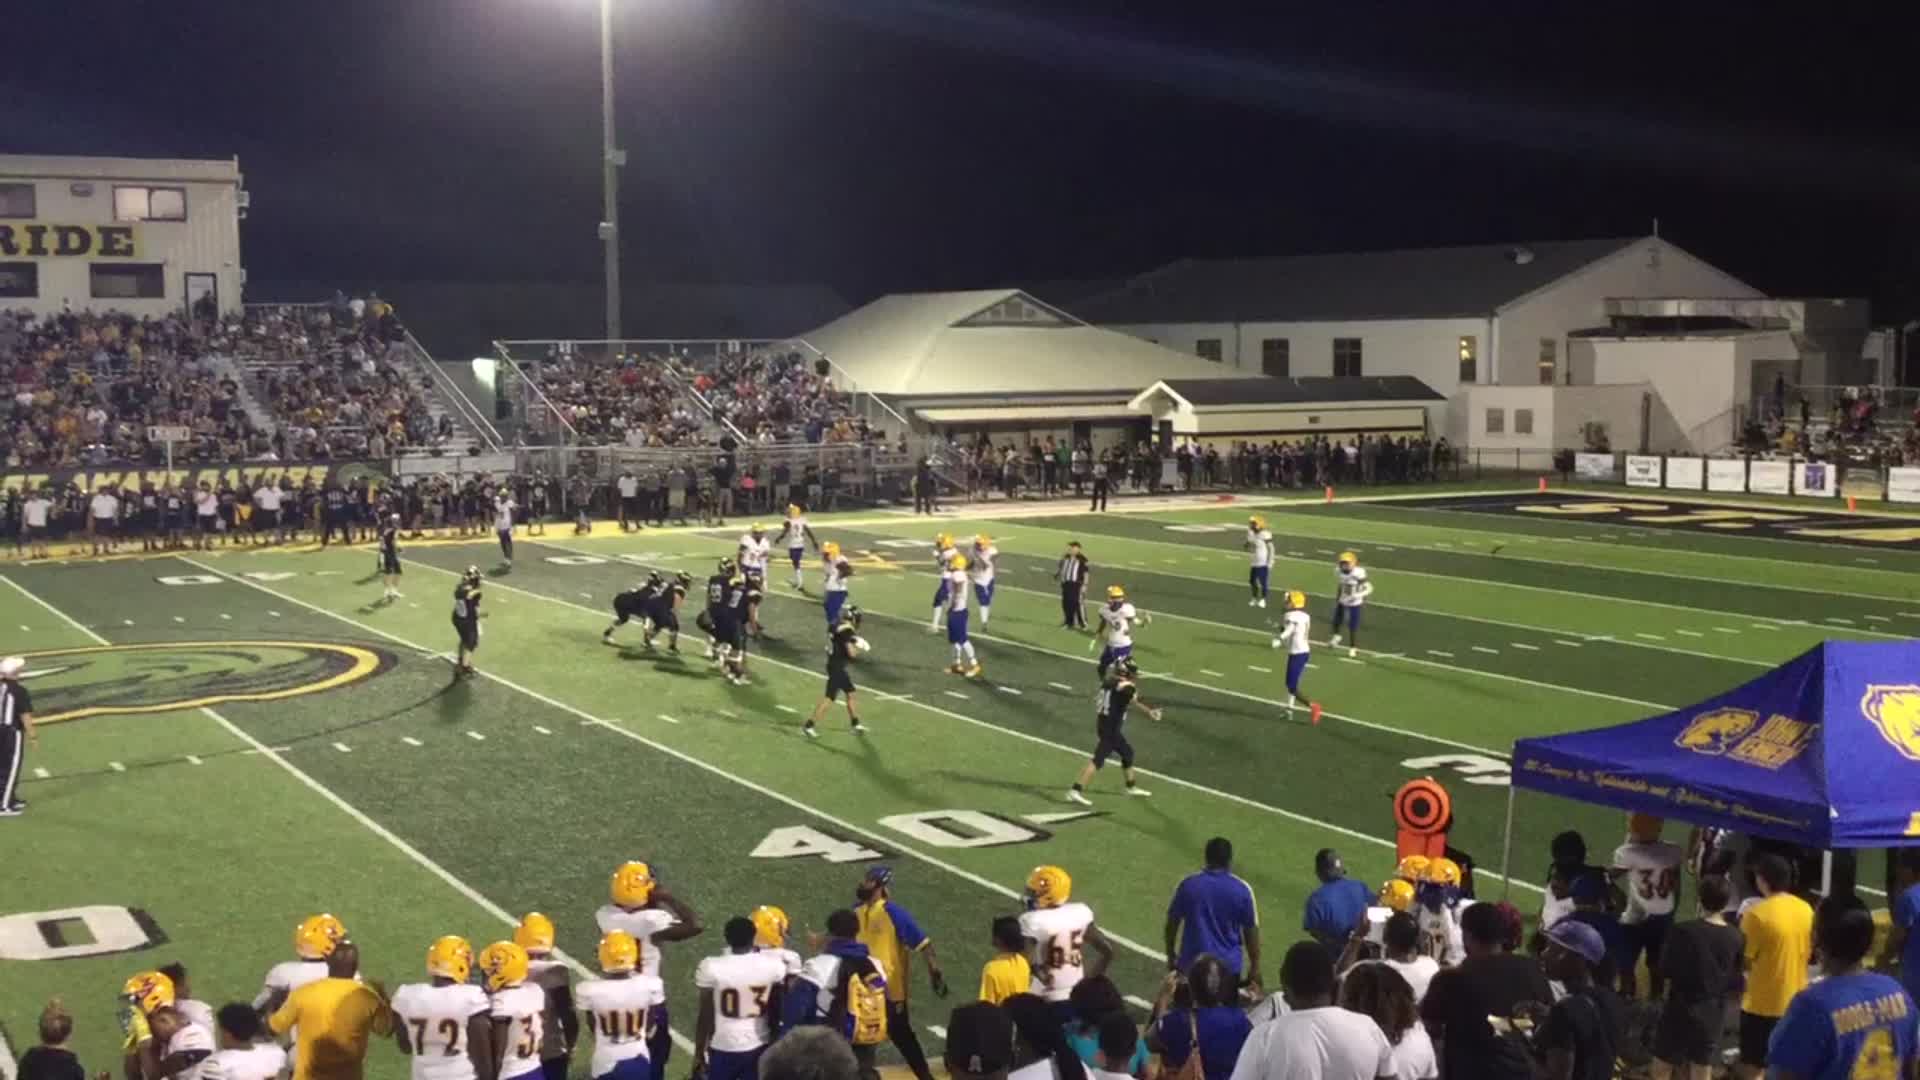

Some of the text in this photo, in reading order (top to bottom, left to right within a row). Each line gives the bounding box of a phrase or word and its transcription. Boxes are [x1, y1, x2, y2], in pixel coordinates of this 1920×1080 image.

[0, 225, 134, 256] RIDE
[750, 810, 1037, 863] 40
[408, 1018, 460, 1056] 72
[1852, 1029, 1898, 1080] 4
